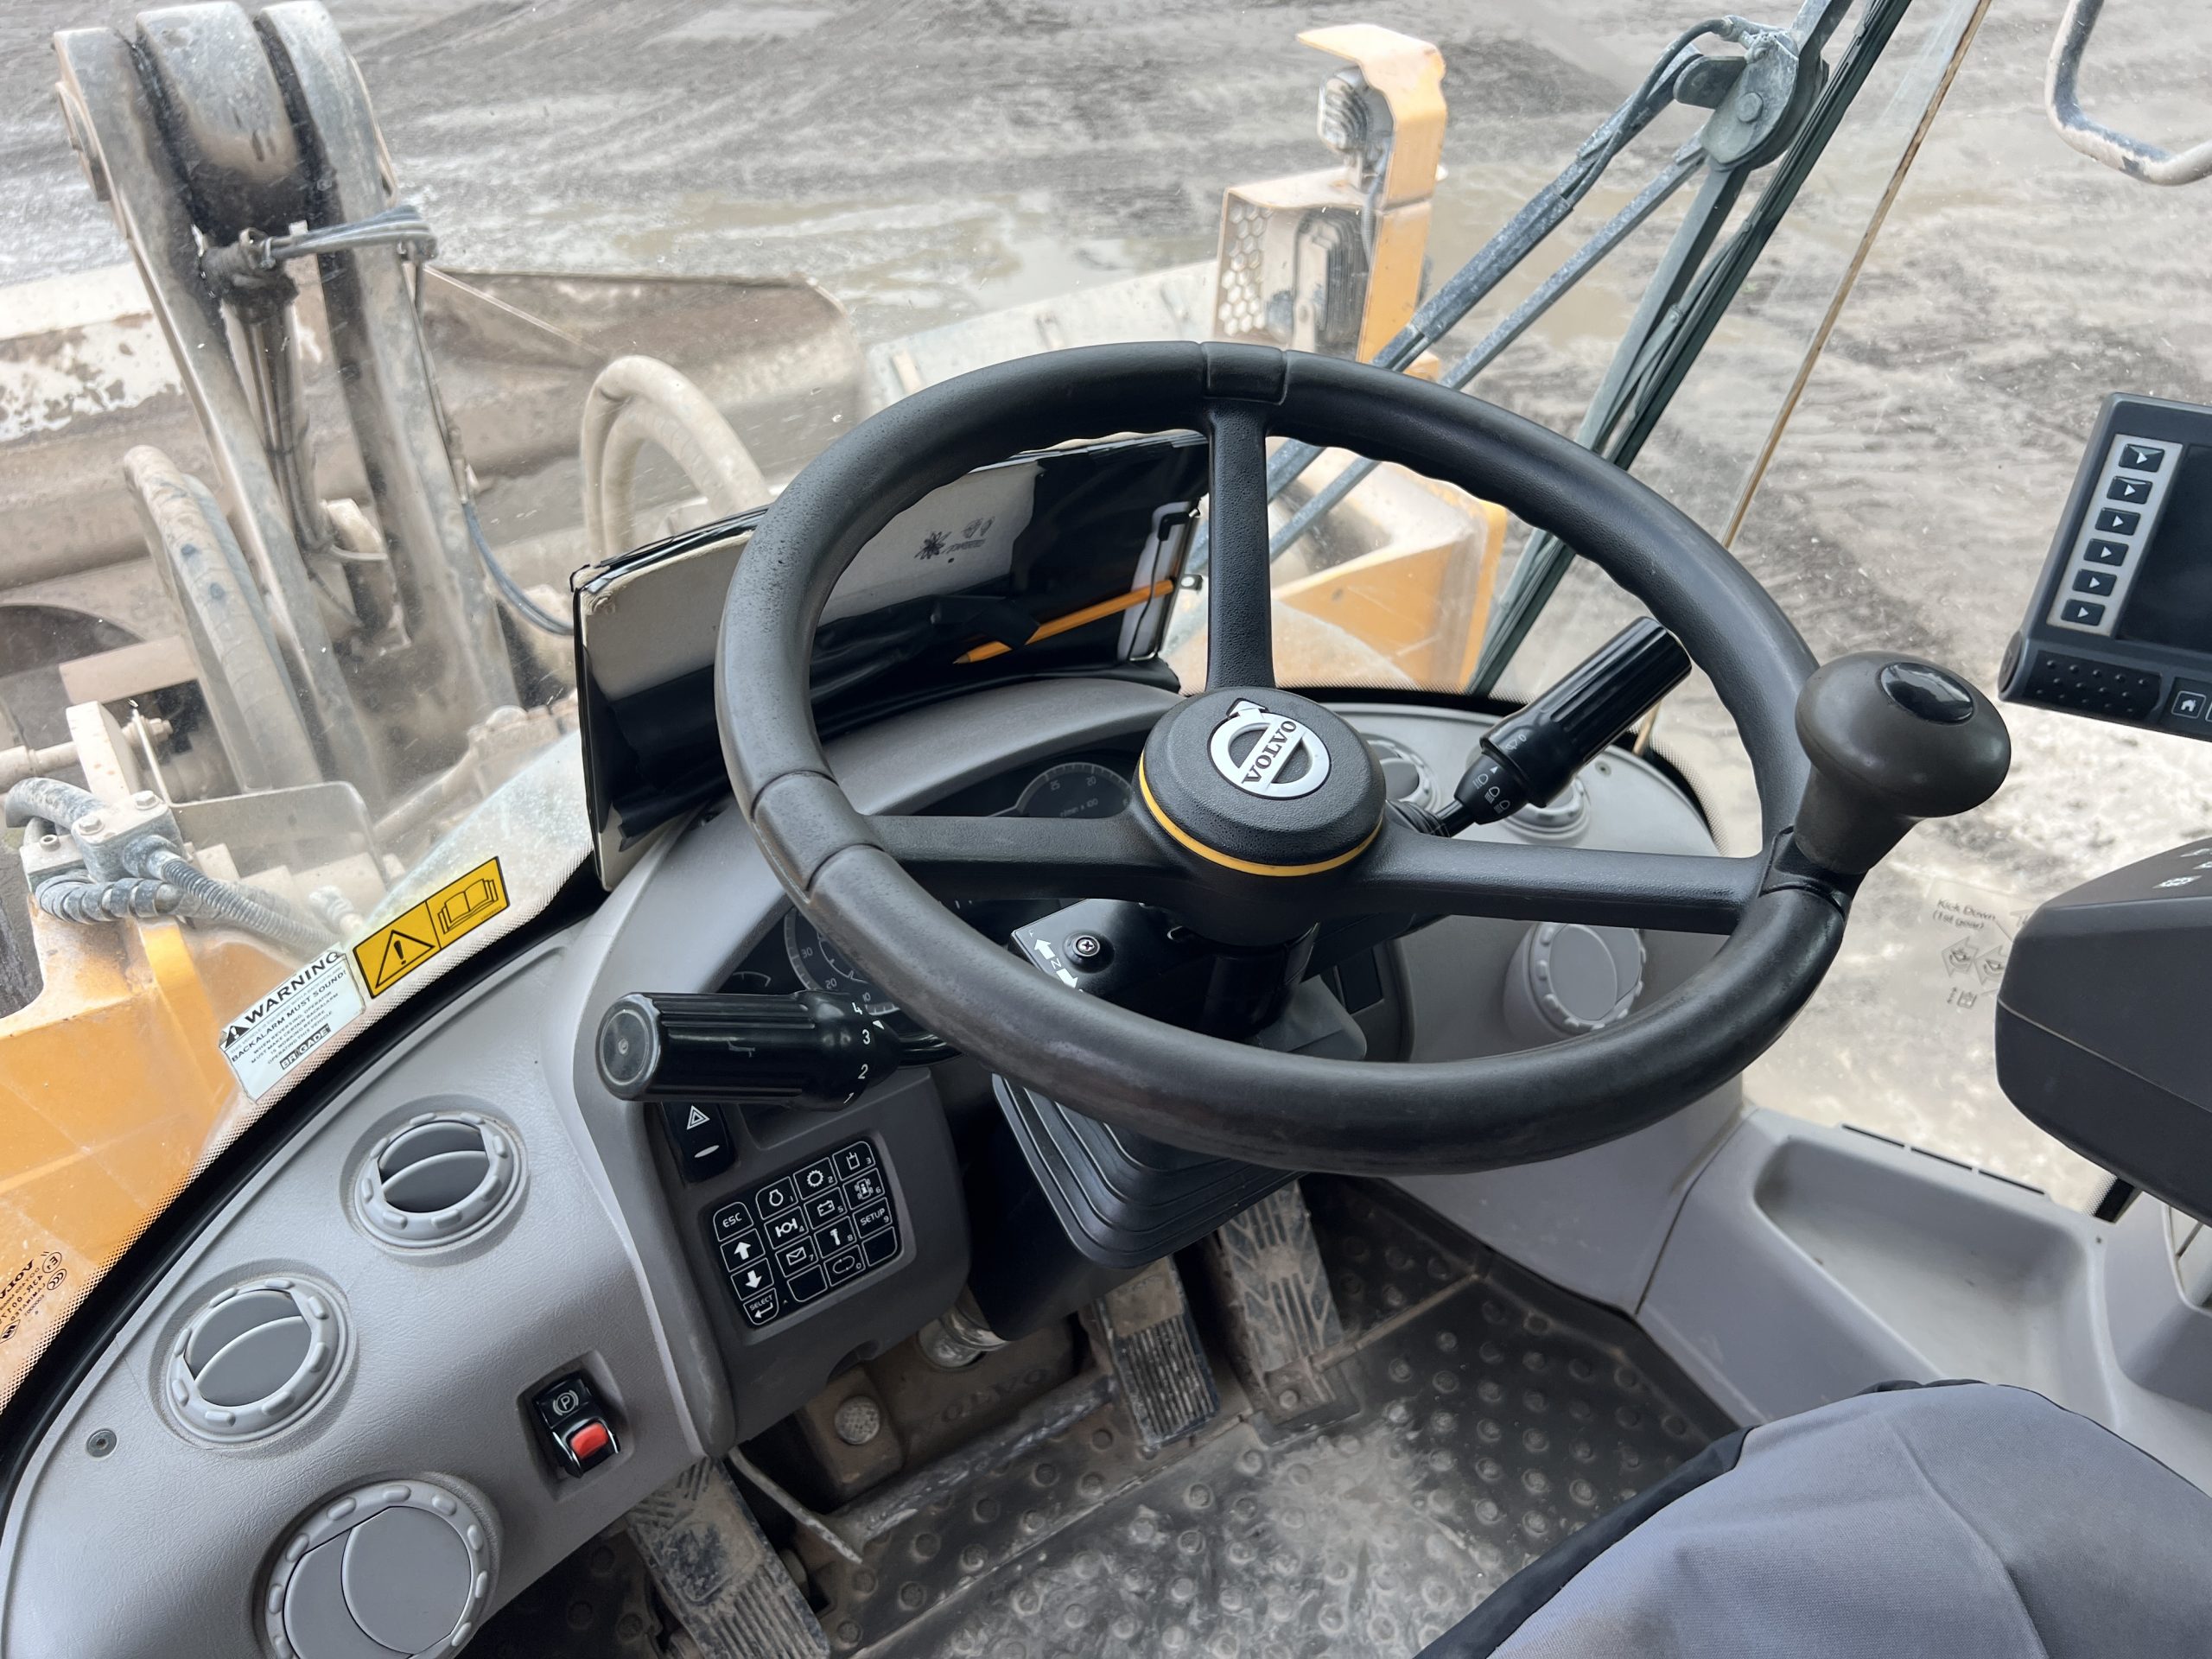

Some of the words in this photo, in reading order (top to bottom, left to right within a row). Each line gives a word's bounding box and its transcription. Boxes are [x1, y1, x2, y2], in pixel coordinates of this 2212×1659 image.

[1243, 720, 1297, 785] VOLVO
[801, 947, 813, 958] 30
[1051, 958, 1061, 969] N
[245, 950, 339, 1024] WARNING
[825, 978, 837, 989] 20
[851, 1002, 863, 1015] 4
[232, 1016, 284, 1062] BACKALARM
[286, 995, 311, 1017] MUST
[861, 1029, 871, 1045] 3
[858, 1064, 868, 1079] 2
[722, 1212, 742, 1228] ESC
[860, 1208, 886, 1225] SETUP
[883, 1215, 890, 1224] 9
[749, 1295, 772, 1312] SELECT
